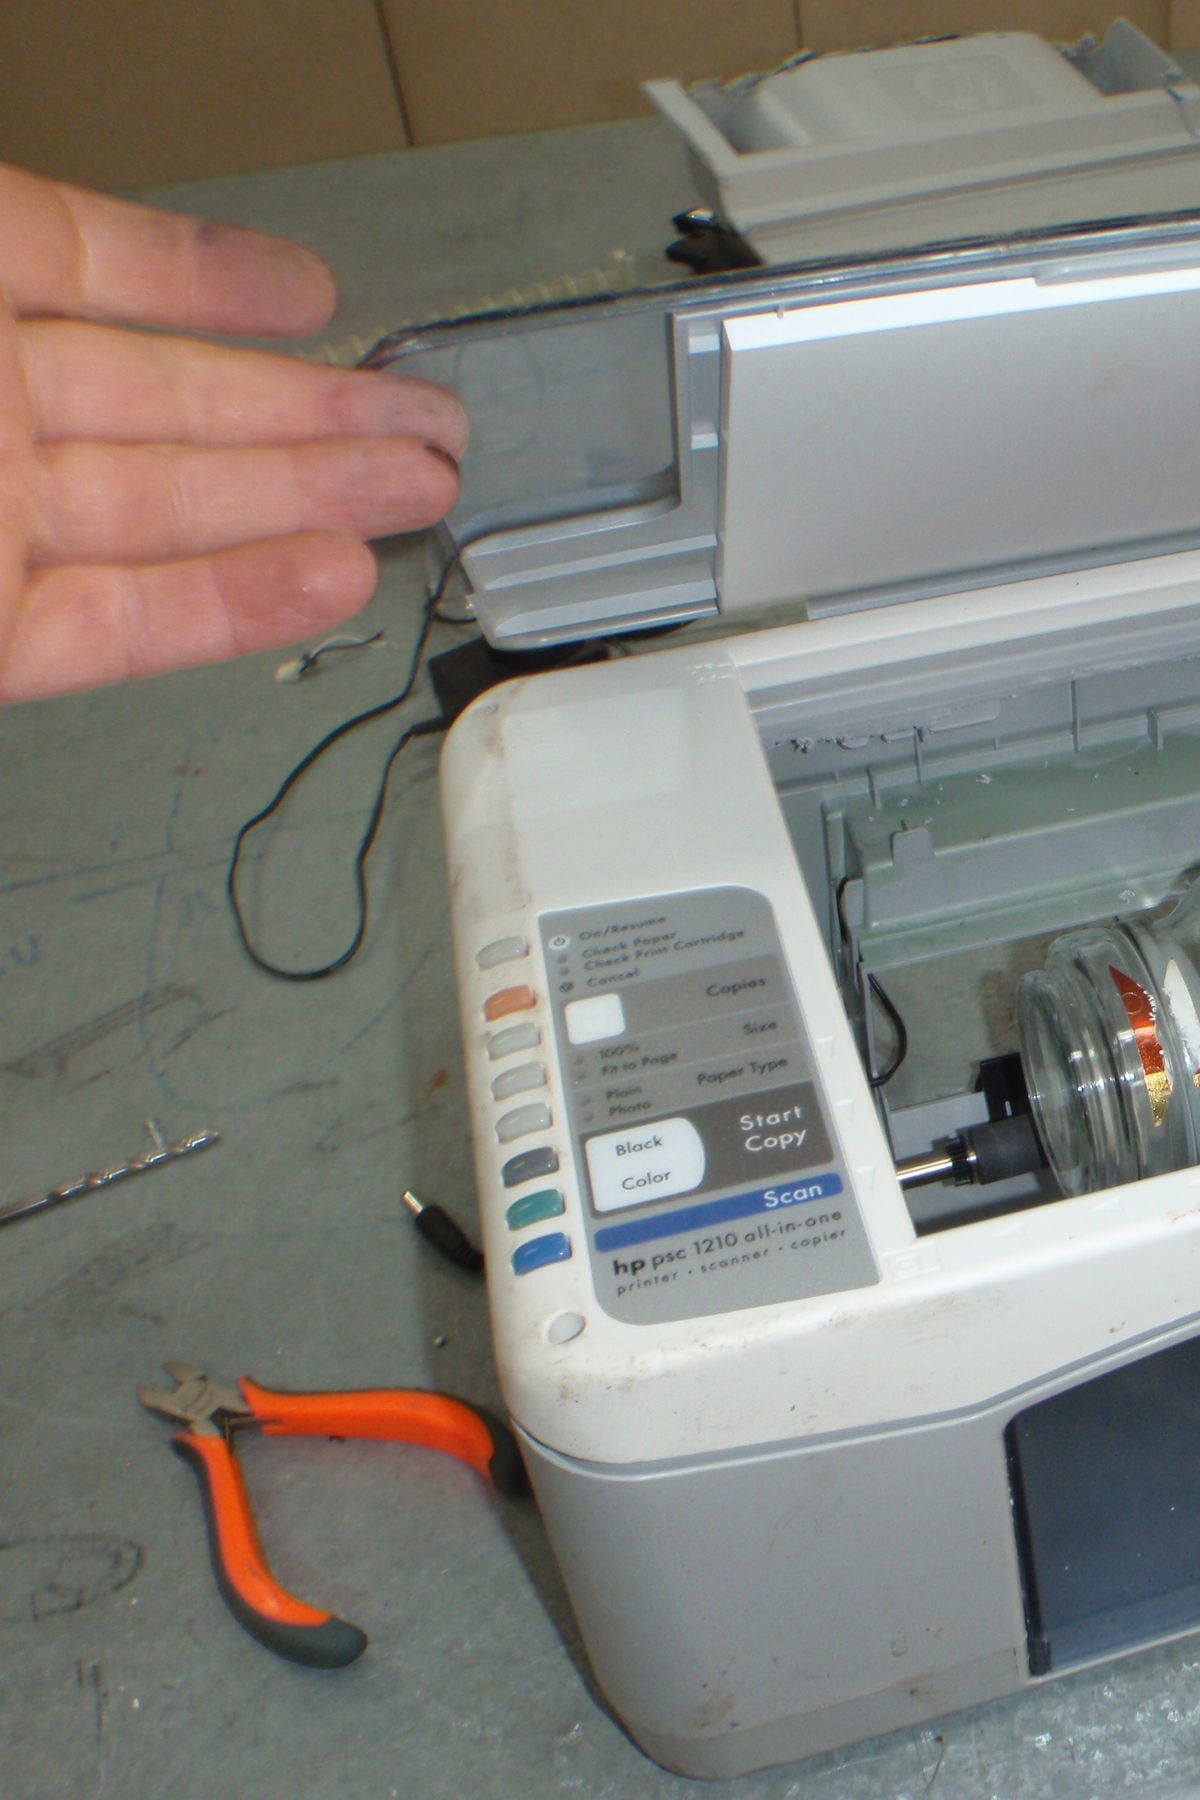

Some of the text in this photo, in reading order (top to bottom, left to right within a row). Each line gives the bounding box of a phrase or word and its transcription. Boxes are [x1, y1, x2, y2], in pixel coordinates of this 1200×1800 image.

[579, 916, 667, 941] On/Resume
[581, 932, 677, 959] Check Paper
[584, 930, 745, 971] Check Print Cartridge
[586, 968, 640, 988] Cancel
[706, 977, 768, 997] Copies
[742, 1020, 779, 1036] Size
[602, 1051, 678, 1077] Fit to Page
[697, 1057, 789, 1086] Paper Type
[605, 1085, 643, 1101] Plain
[608, 1101, 652, 1117] Photo
[739, 1105, 803, 1131] Start
[615, 1135, 664, 1157] Black
[744, 1126, 808, 1153] Copy
[622, 1168, 672, 1191] Color
[763, 1184, 823, 1208] Scan
[613, 1211, 843, 1276] hp psc 1210 all-in-one
[617, 1228, 847, 1297] printer scanner copier
